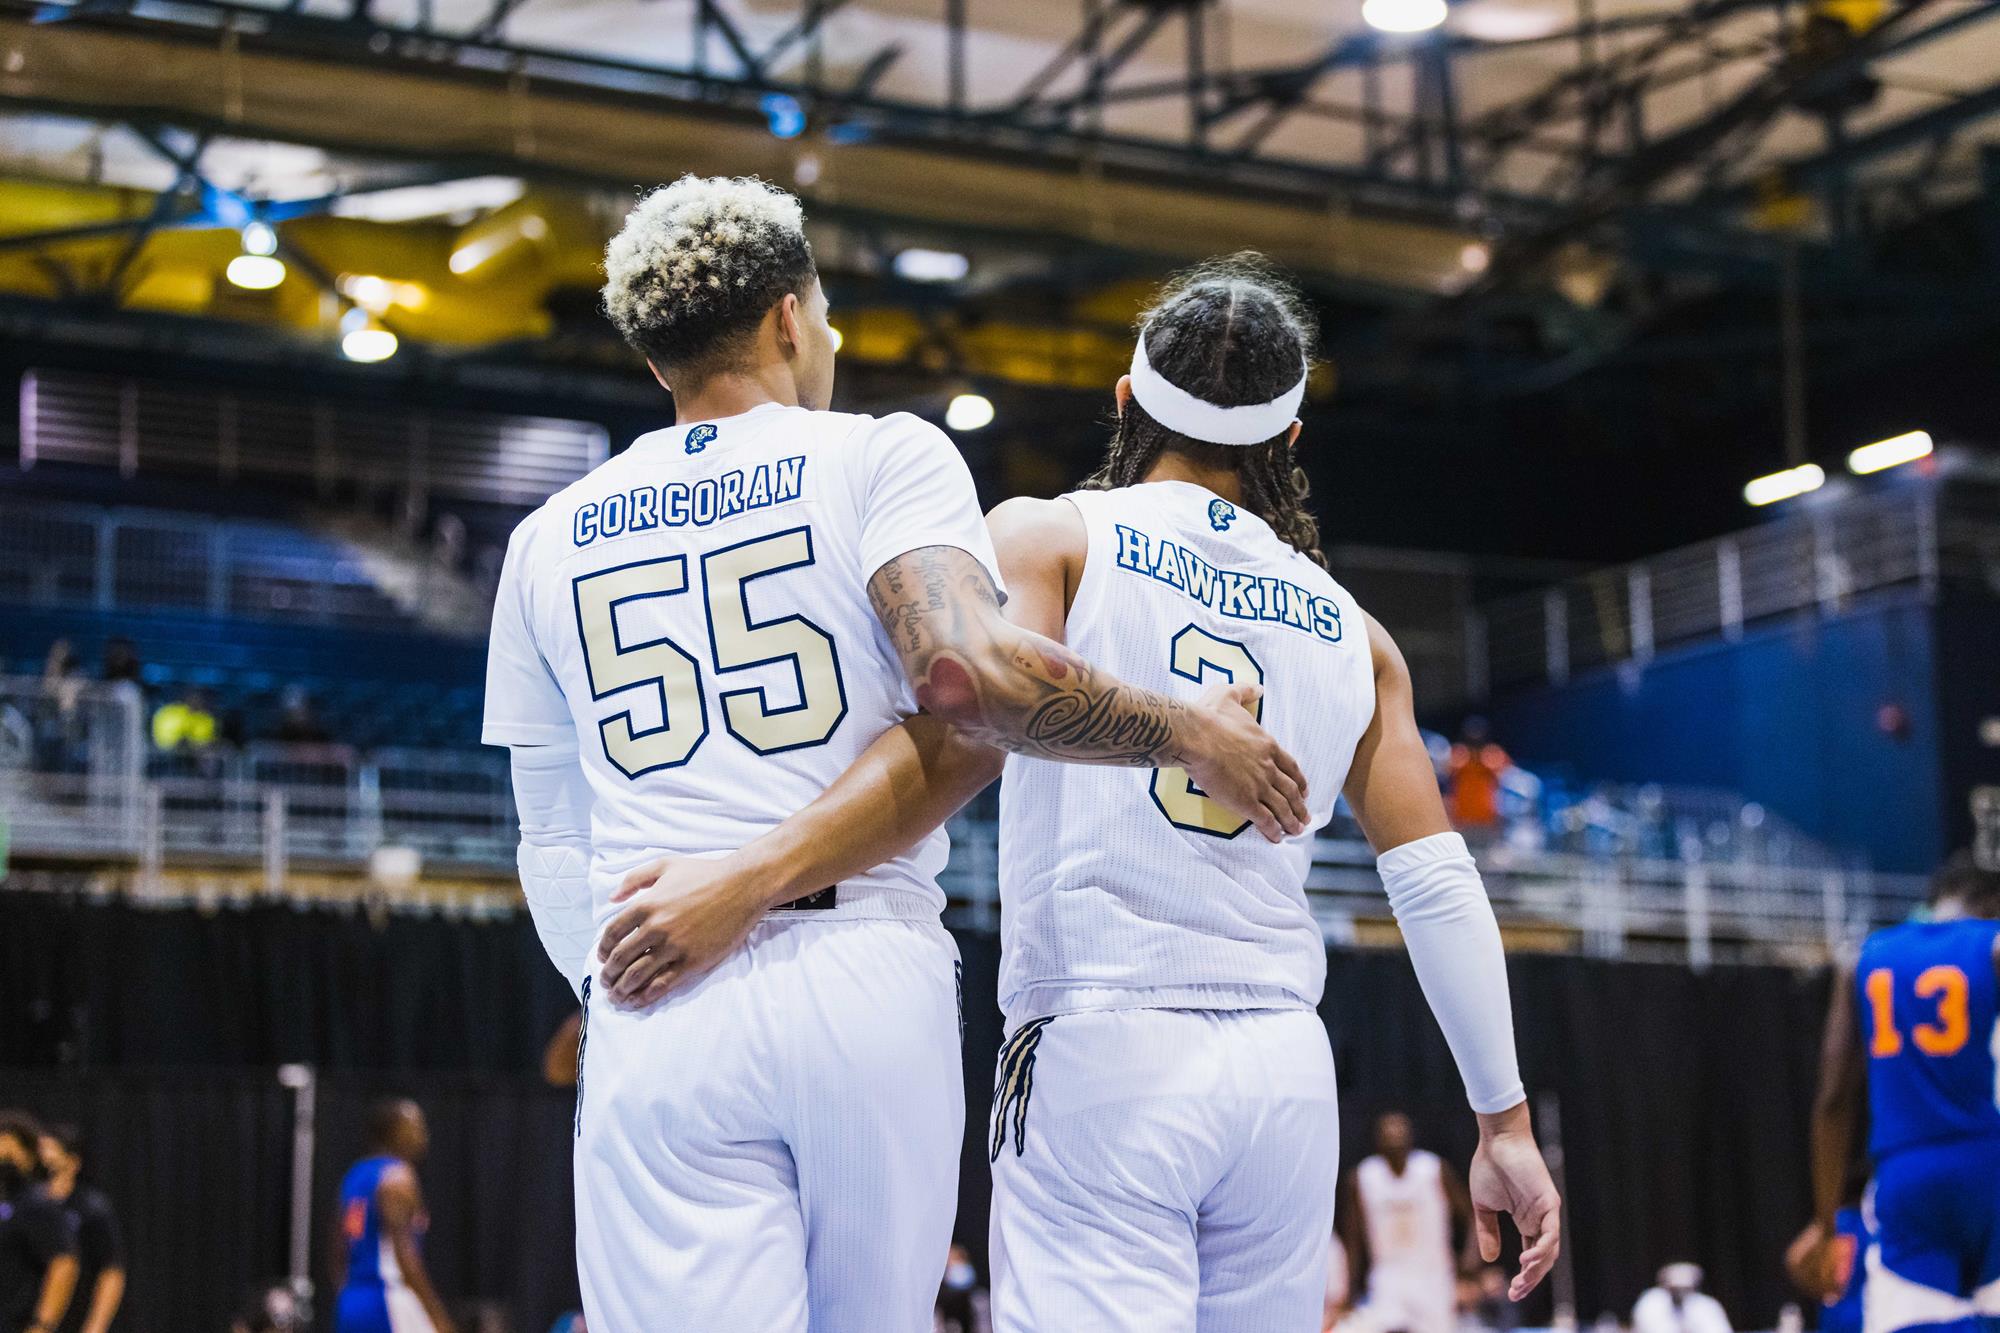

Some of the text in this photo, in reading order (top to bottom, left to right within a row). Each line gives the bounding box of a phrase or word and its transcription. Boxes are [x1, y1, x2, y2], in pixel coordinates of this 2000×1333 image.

[573, 455, 806, 547] CORCORAN
[1115, 523, 1342, 643] HAWKINS
[571, 524, 849, 781] 55
[1025, 686, 1173, 768] Avery
[1865, 964, 1971, 1058] 13
